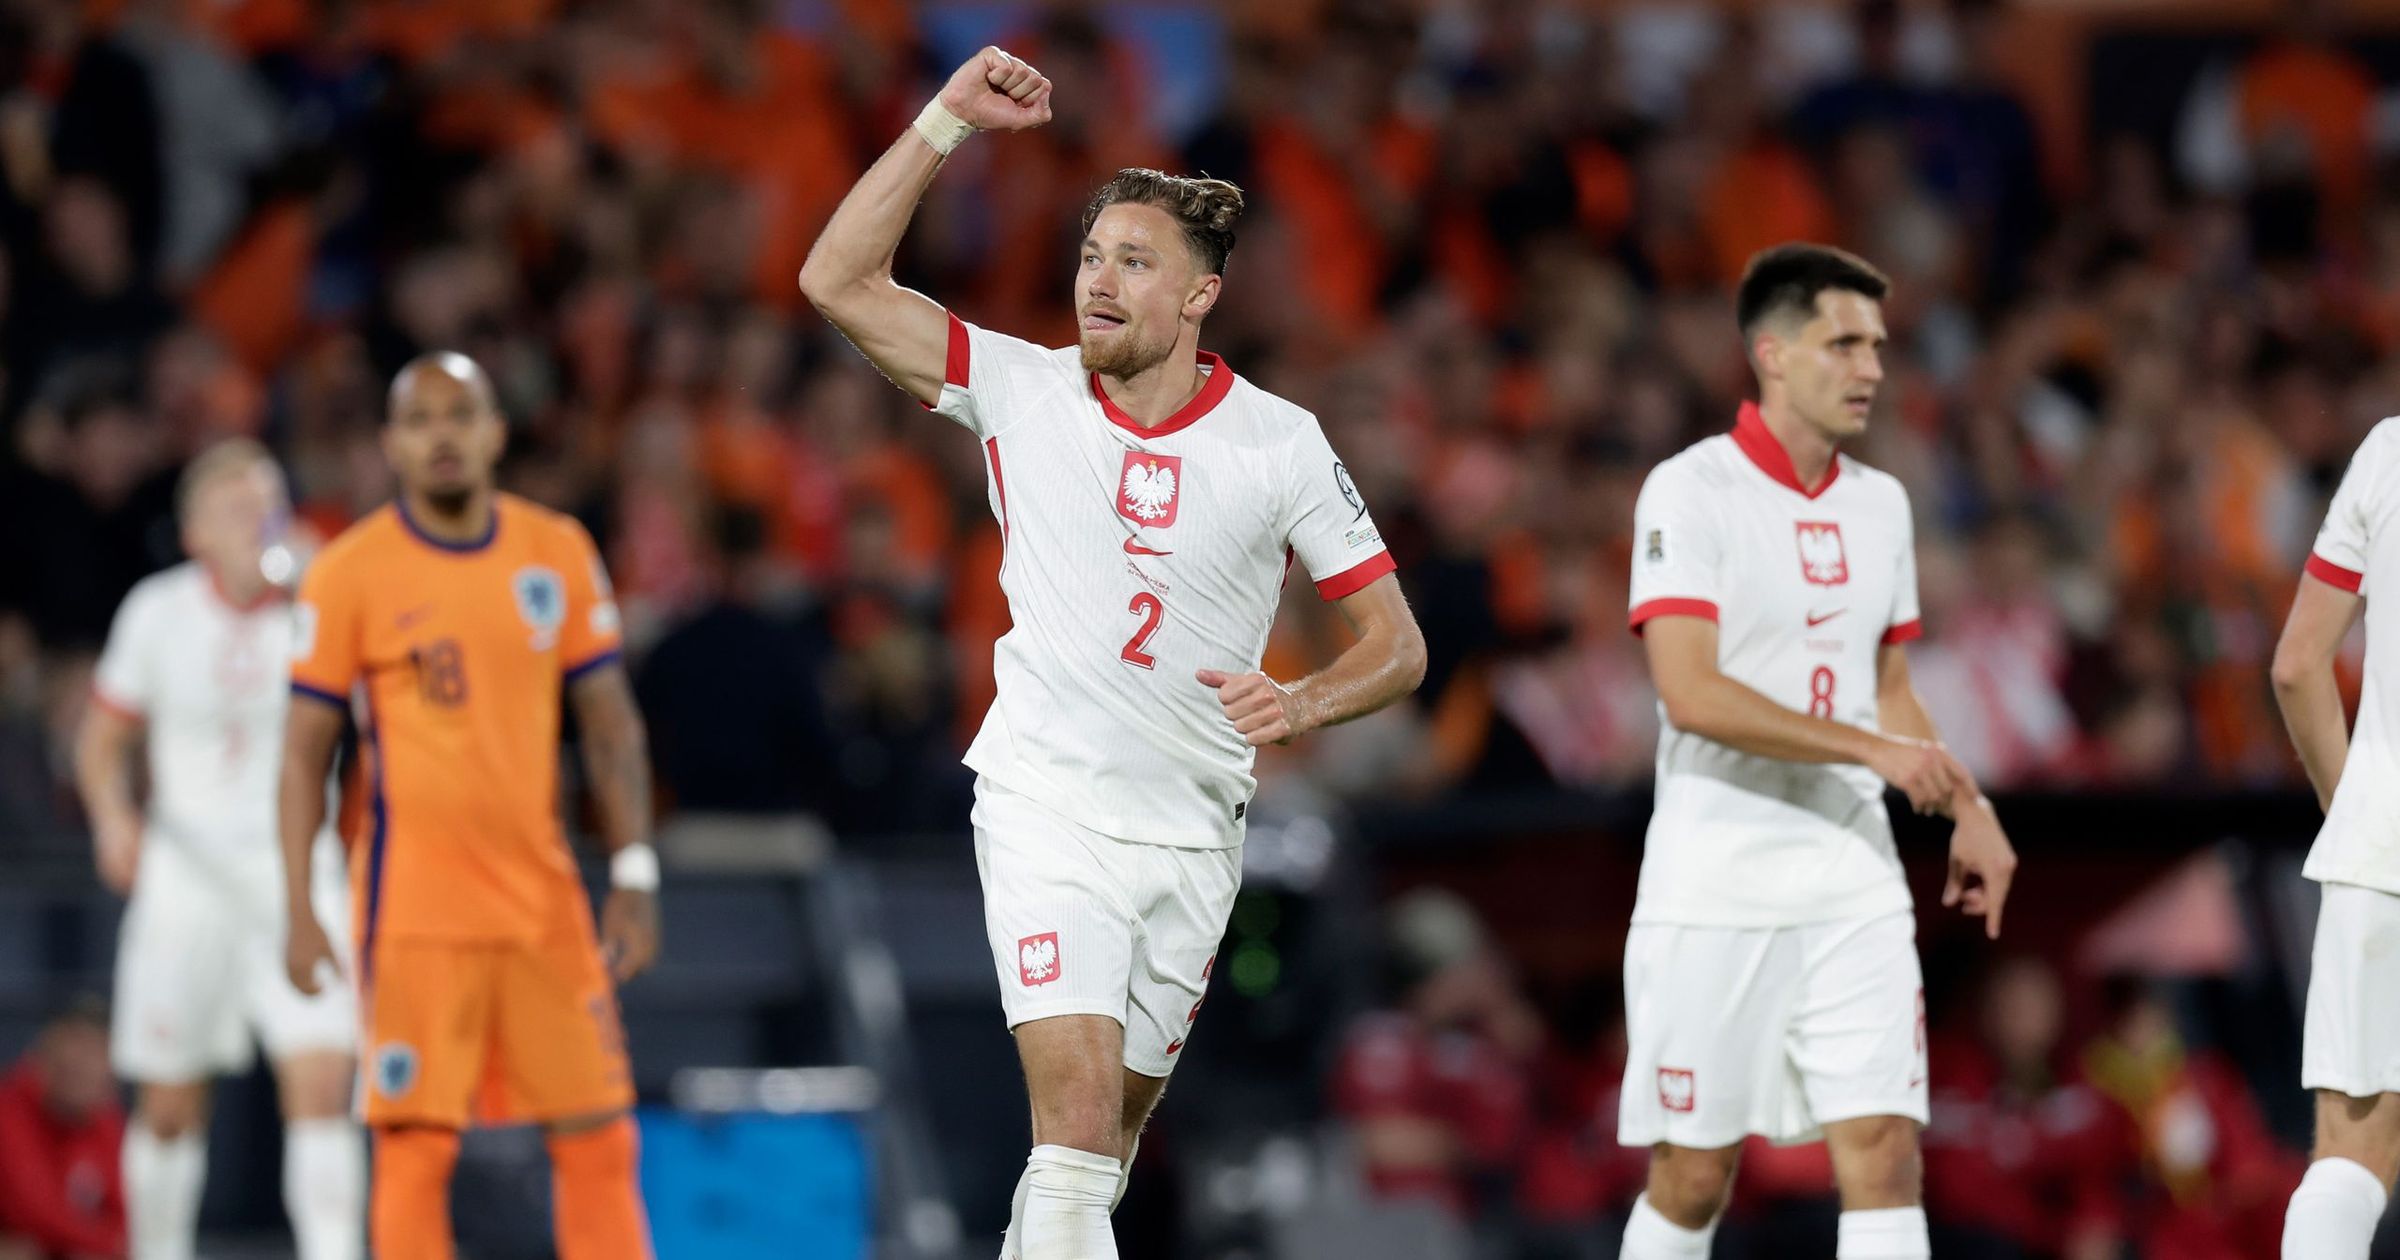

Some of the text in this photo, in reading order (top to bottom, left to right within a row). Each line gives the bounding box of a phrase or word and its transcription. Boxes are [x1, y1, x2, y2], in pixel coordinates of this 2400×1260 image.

[1121, 591, 1164, 670] 2
[409, 637, 468, 708] 18
[1810, 665, 1834, 720] 8
